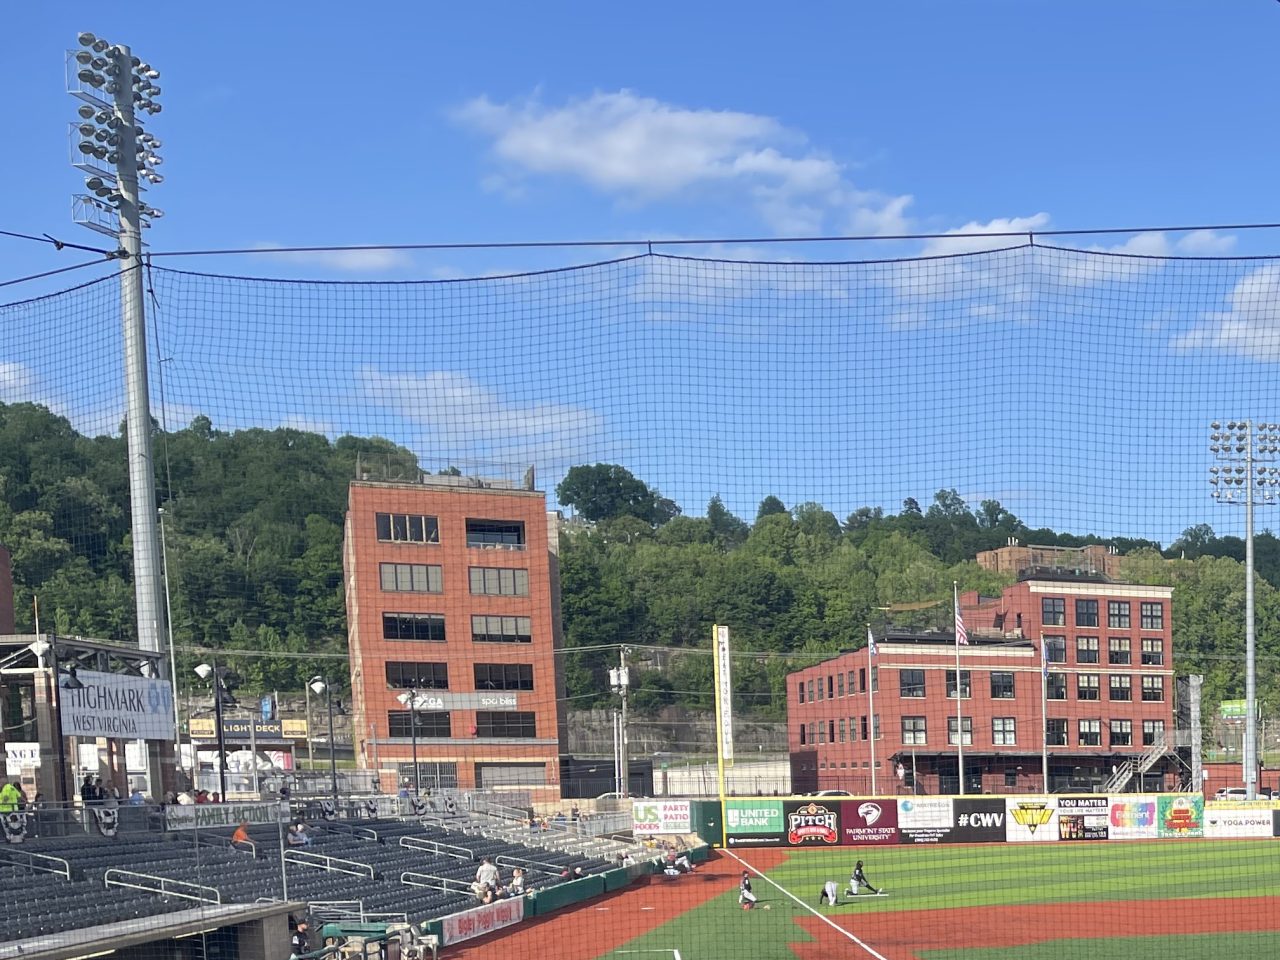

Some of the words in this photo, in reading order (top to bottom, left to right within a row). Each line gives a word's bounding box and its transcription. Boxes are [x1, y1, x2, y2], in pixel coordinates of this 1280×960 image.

[71, 684, 145, 713] HIGHMARK
[72, 714, 96, 732] WEST
[97, 716, 137, 734] VIRGINIA
[223, 724, 252, 732] LIGHT
[255, 724, 280, 734] DECK
[1060, 799, 1076, 807] YOU
[1077, 799, 1107, 807] MATTER
[663, 804, 689, 812] PARTY
[740, 808, 779, 817] UNITED
[663, 813, 689, 821] PATIO
[740, 817, 769, 826] BANK
[957, 812, 1004, 828] #CWV
[634, 823, 660, 831] FOODS
[790, 814, 835, 831] PITCH
[846, 827, 877, 835] FAIRMONT
[852, 833, 890, 841] UNIVERSITY
